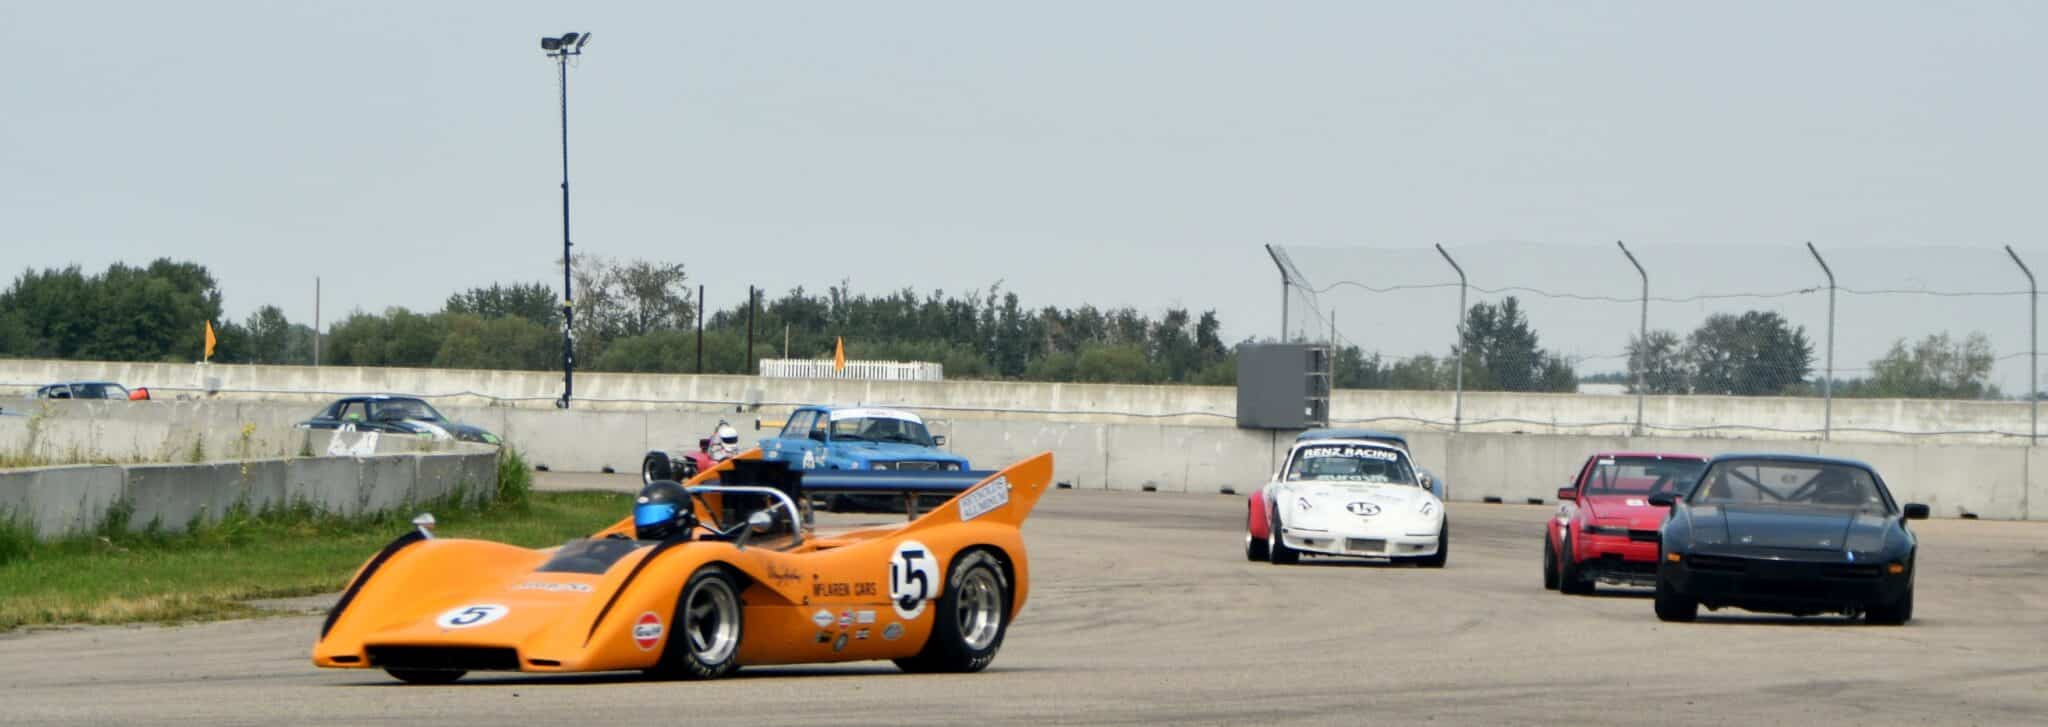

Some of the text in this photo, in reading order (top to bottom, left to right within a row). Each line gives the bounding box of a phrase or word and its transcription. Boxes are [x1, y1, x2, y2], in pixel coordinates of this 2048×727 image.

[1304, 447, 1397, 461] RENZ RACING
[855, 582, 876, 596] CARS
[450, 607, 496, 625] 5
